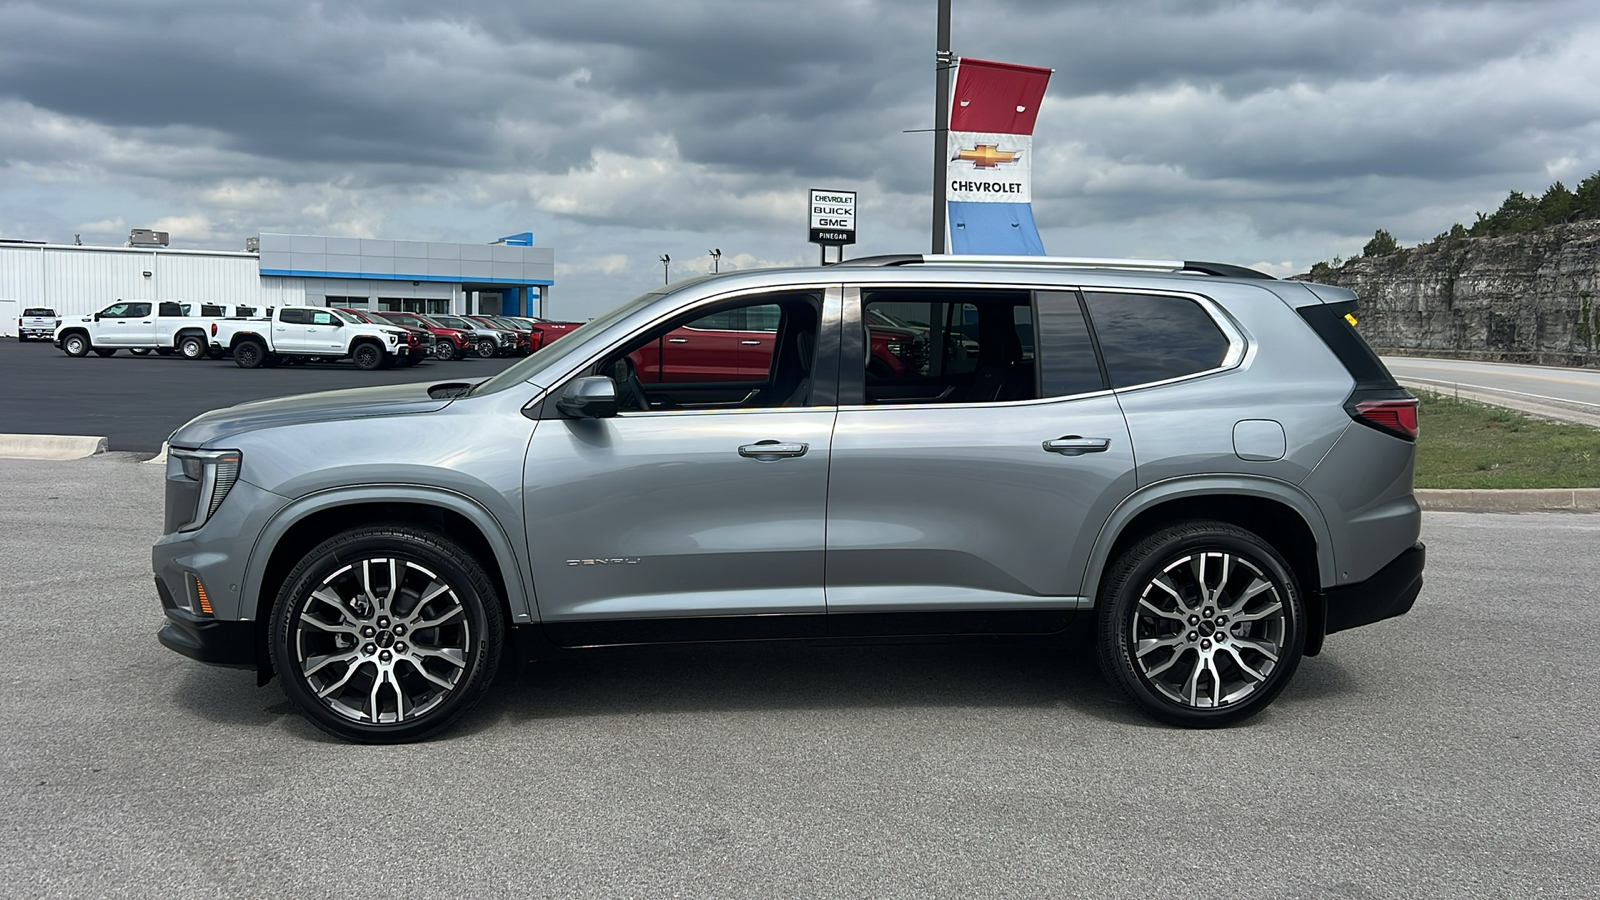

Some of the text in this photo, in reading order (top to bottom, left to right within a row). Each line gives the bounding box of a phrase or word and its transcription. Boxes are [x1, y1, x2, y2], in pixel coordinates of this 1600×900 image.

[951, 180, 1022, 193] CHEVROLET
[815, 195, 853, 204] CHEVROLET
[813, 206, 853, 216] BUICK
[819, 218, 848, 227] GMC
[819, 232, 847, 240] PINEGAR
